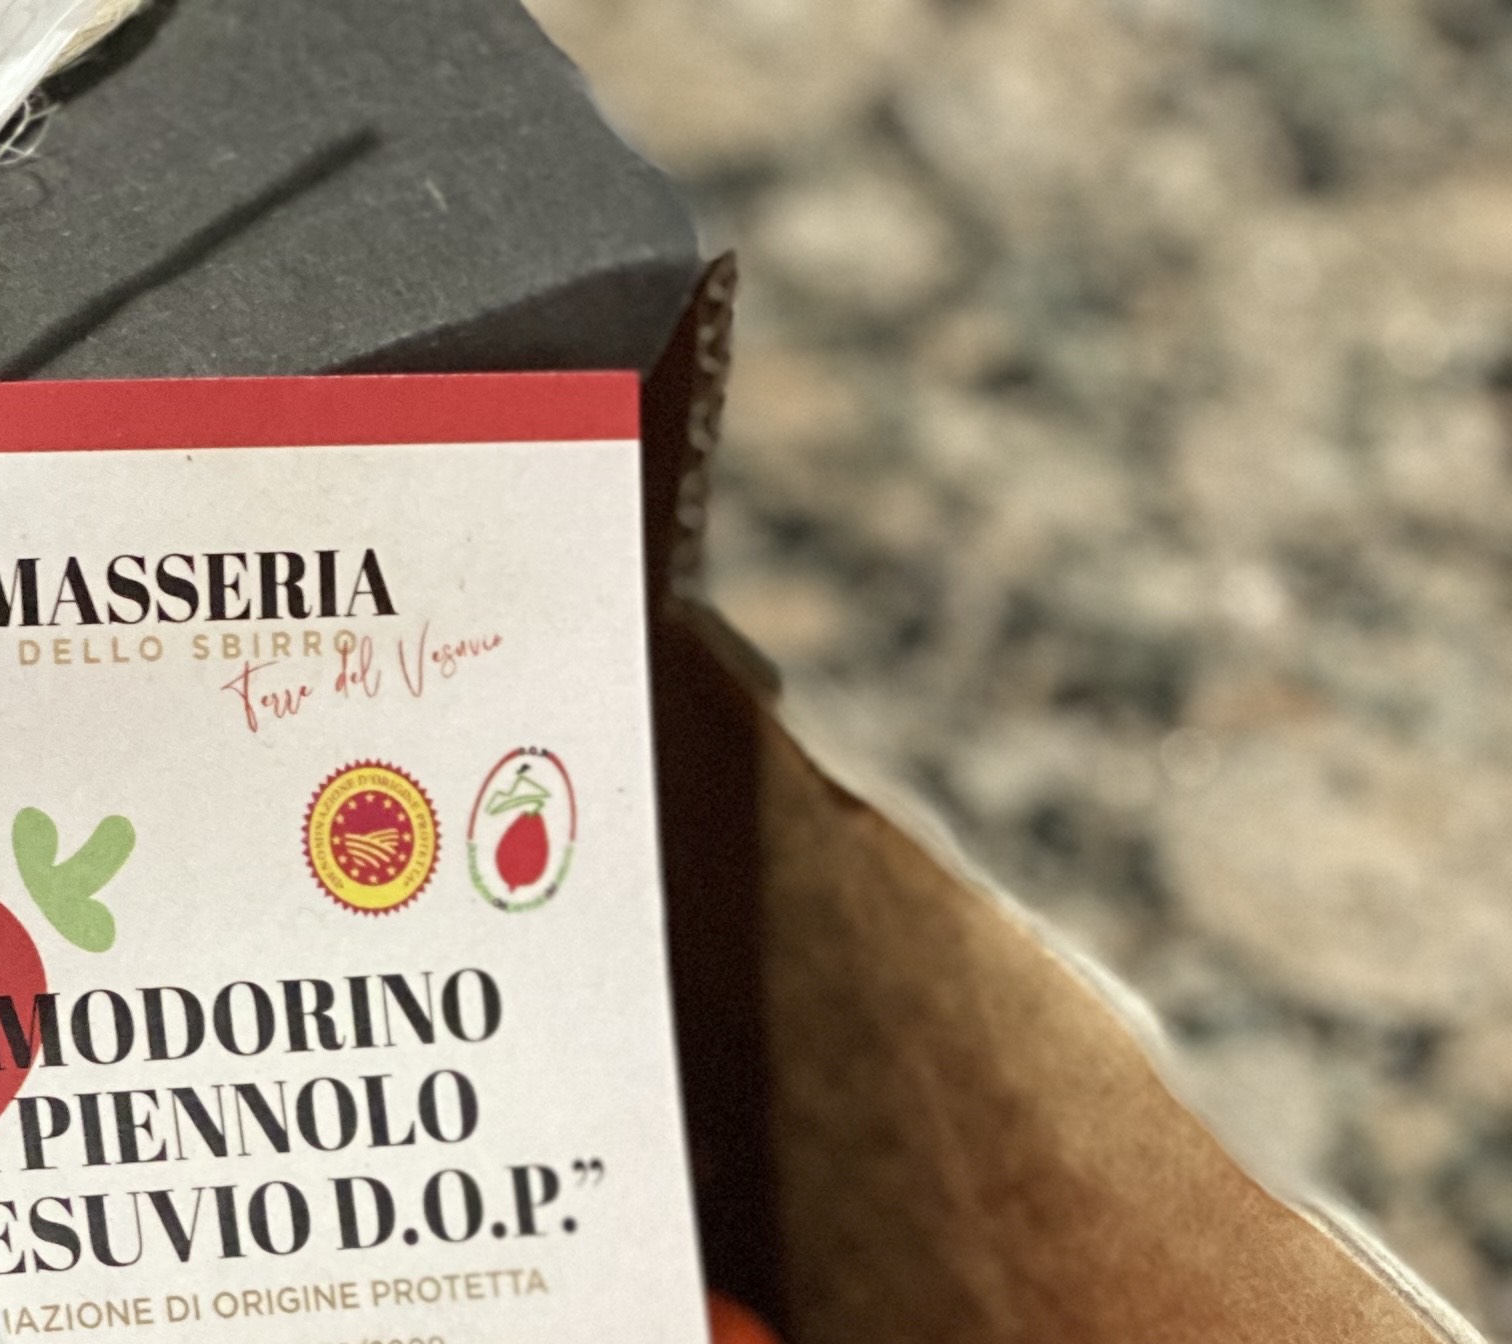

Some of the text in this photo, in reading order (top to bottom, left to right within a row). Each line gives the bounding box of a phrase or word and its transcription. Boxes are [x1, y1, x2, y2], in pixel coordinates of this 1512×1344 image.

[18, 629, 357, 666] DELLO SBIRRO
[335, 635, 382, 699] del
[12, 1069, 480, 1172] PIENNOLO
[167, 1294, 201, 1323] DI
[213, 1282, 361, 1319] ORIGINE
[372, 1268, 548, 1307] PROTETTA
